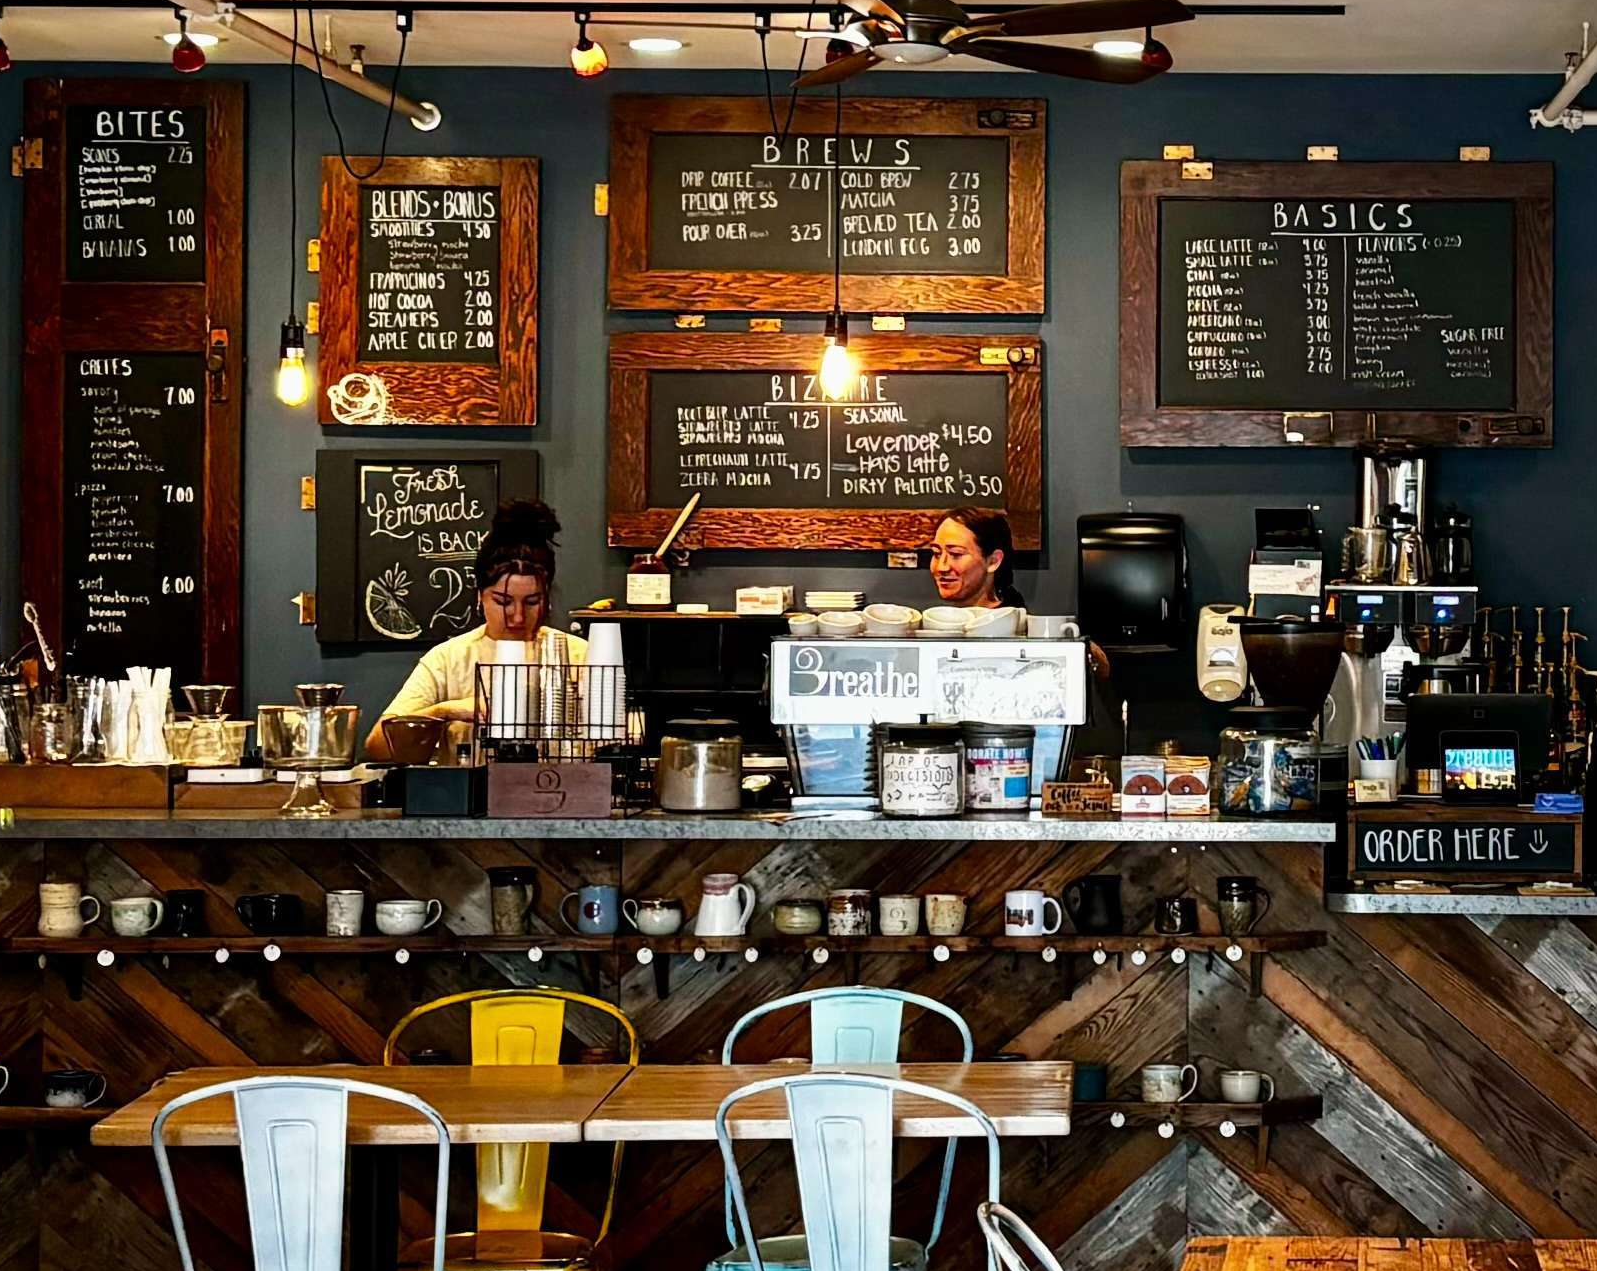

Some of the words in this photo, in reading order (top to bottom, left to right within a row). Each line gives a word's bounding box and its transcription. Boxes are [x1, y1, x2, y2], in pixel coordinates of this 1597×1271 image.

[96, 109, 185, 138] BITES
[763, 135, 911, 166] BREWS
[839, 171, 874, 189] COLD
[880, 171, 913, 189] BREW
[371, 189, 431, 219] BLENDS
[443, 190, 496, 220] BONUS
[733, 190, 779, 210] PRESS
[903, 211, 939, 233] TEA
[1273, 202, 1413, 232] BASICS
[947, 237, 982, 257] 3.00
[1219, 238, 1254, 253] LATTE
[1357, 236, 1418, 253] FLAVORS
[1219, 254, 1254, 268] LATTE
[1185, 269, 1216, 283] CHAI
[368, 292, 392, 310] HOT
[396, 293, 434, 310] COCOA
[368, 331, 410, 352] APPLE
[1440, 328, 1478, 344] SUGAR
[1481, 326, 1506, 342] FREE
[842, 405, 909, 425] SEASONAL
[941, 422, 993, 447] $4.50
[725, 471, 772, 486] MOCHA
[417, 533, 434, 553] IS
[792, 646, 919, 698] Breathe
[1363, 828, 1444, 863] ORDER
[1453, 827, 1520, 862] HERE
